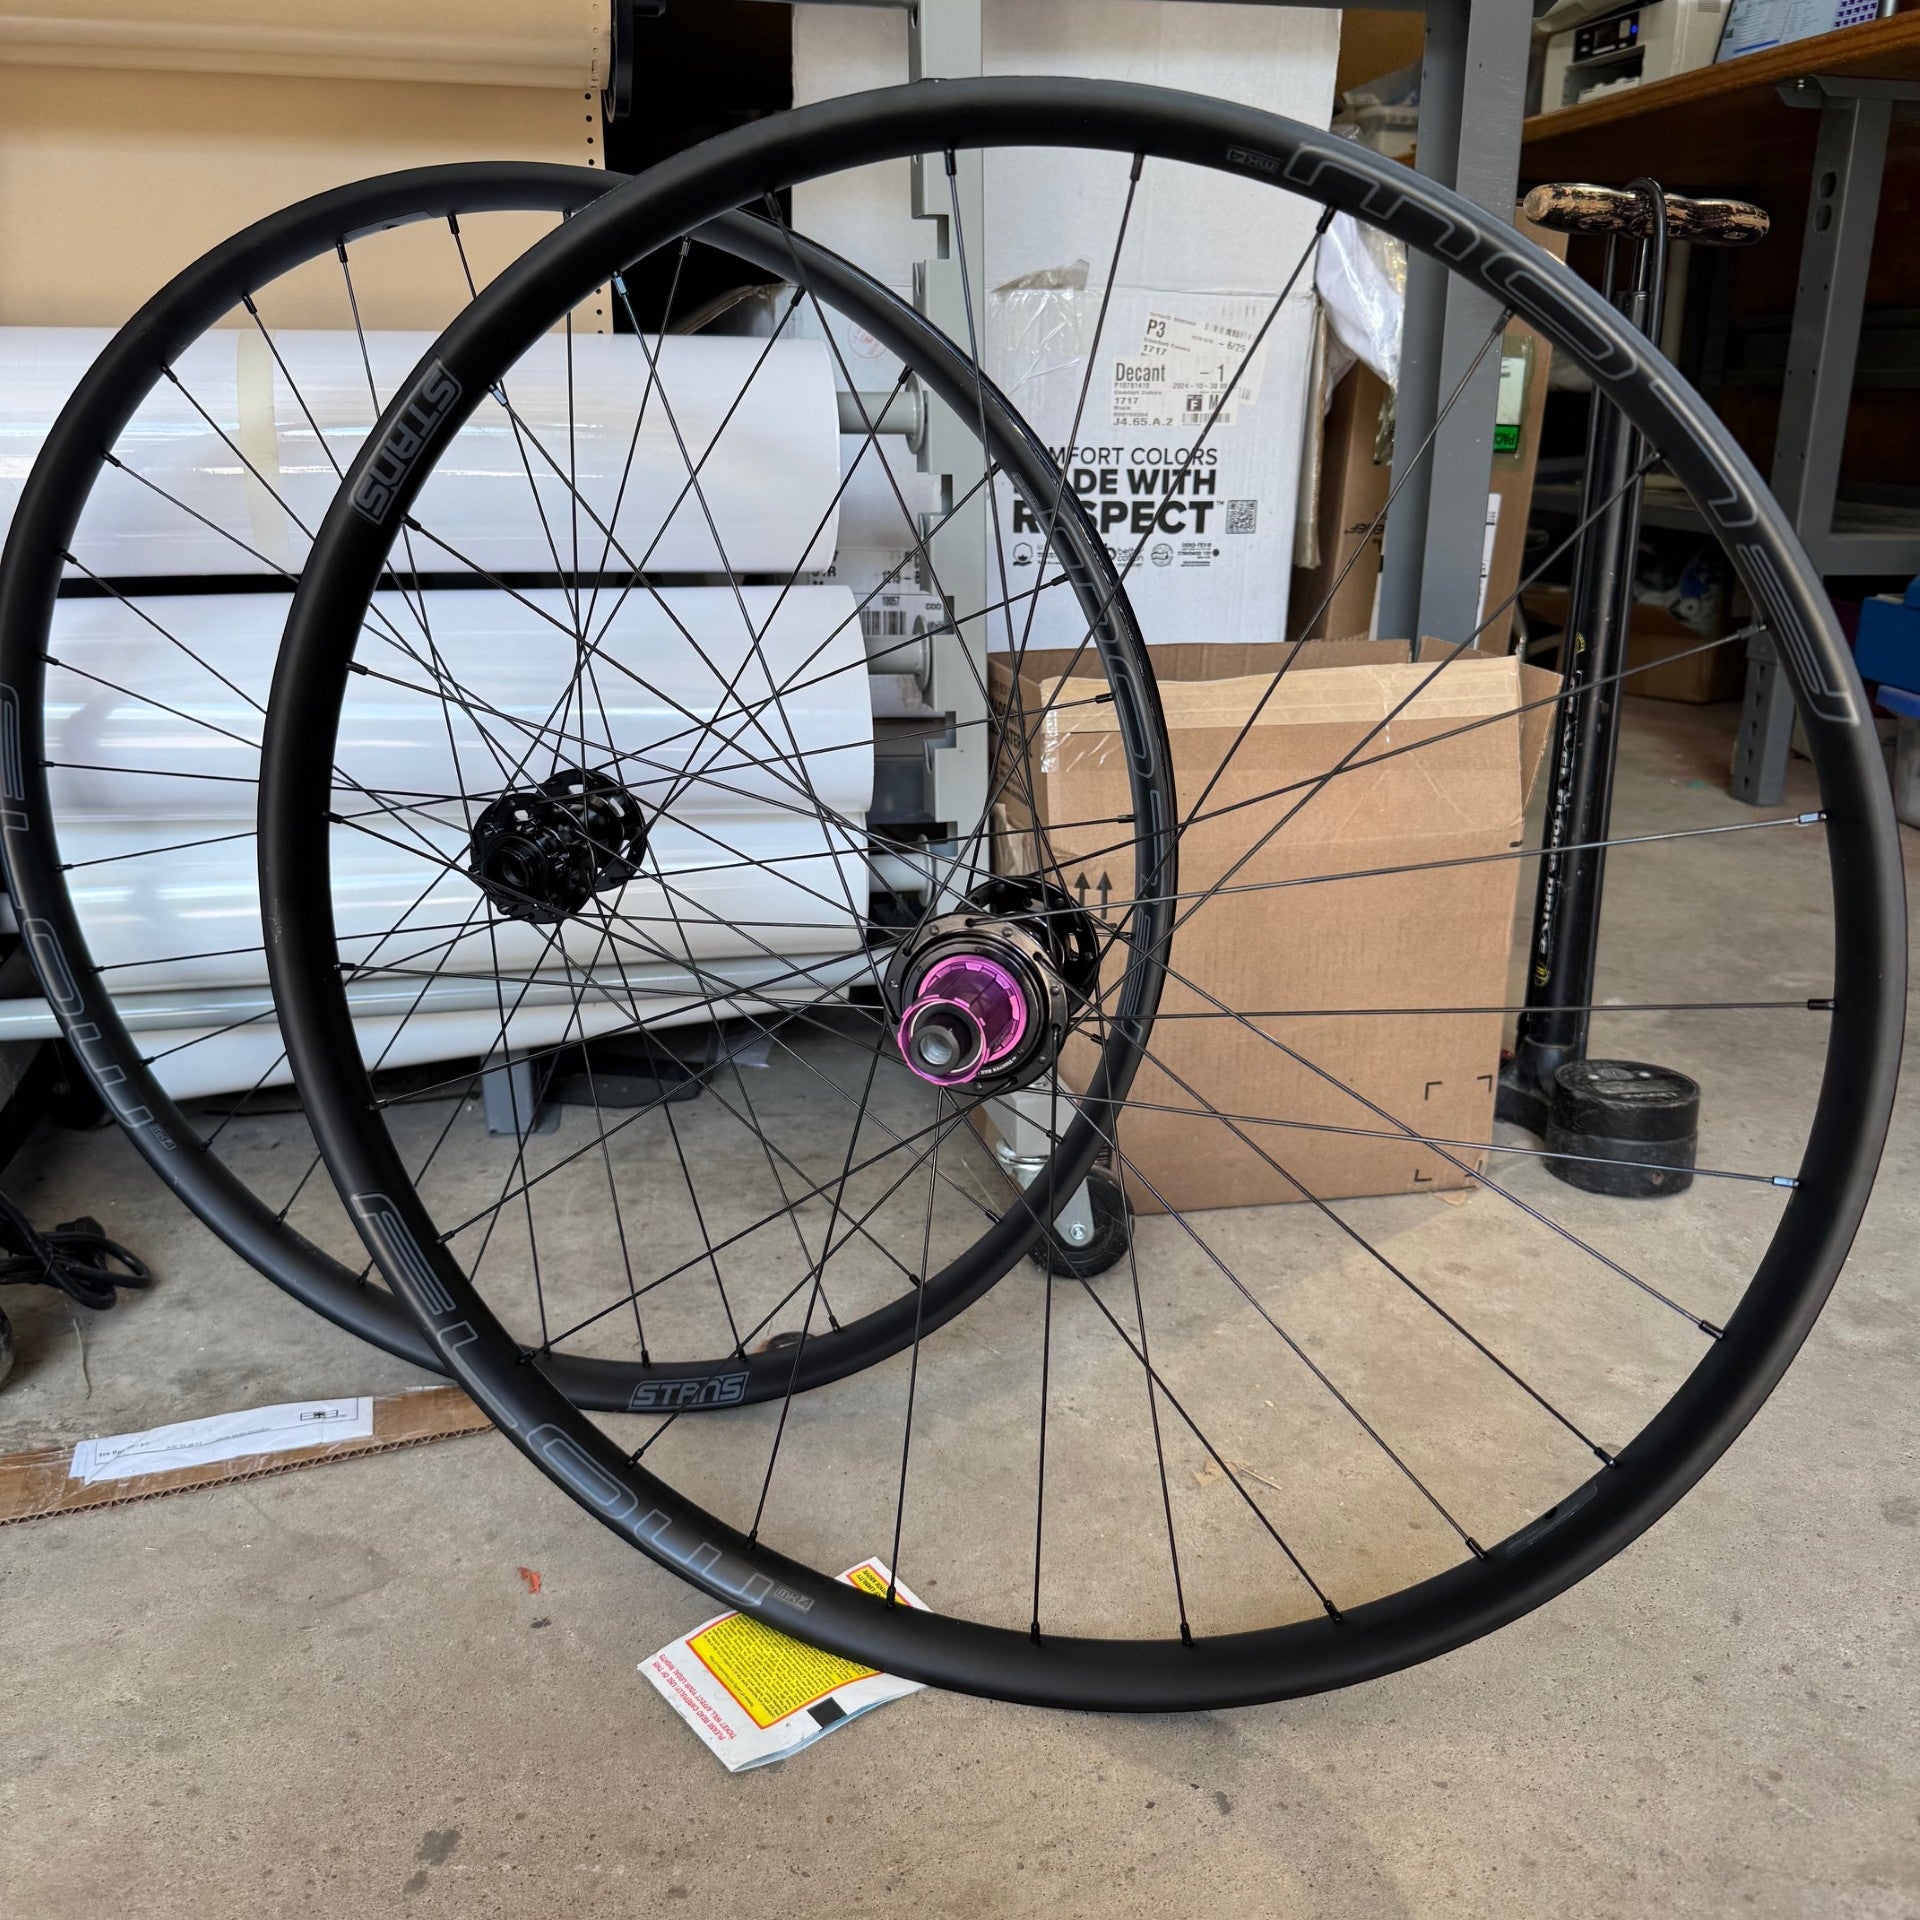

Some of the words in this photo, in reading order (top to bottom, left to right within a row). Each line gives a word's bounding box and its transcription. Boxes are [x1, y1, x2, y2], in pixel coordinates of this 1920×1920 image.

[1146, 319, 1166, 338] P3
[1115, 362, 1166, 382] Decant
[1115, 397, 1139, 405] 1717
[354, 366, 458, 520] STANS
[1049, 446, 1124, 466] MFORT
[1131, 446, 1218, 466] COLORS
[1127, 468, 1216, 495] WITH
[1012, 499, 1213, 535] RSPECT
[1539, 876, 1555, 955] DRIVE
[659, 1654, 675, 1671] RIGHTS
[673, 1669, 688, 1683] LEGAL
[684, 1682, 697, 1696] YOUR
[674, 1686, 699, 1712] CAREFULLY
[695, 1694, 713, 1712] AFFECT
[697, 1711, 711, 1724] READ
[707, 1720, 726, 1740] PLEASE
[720, 1721, 737, 1740] TICKET
